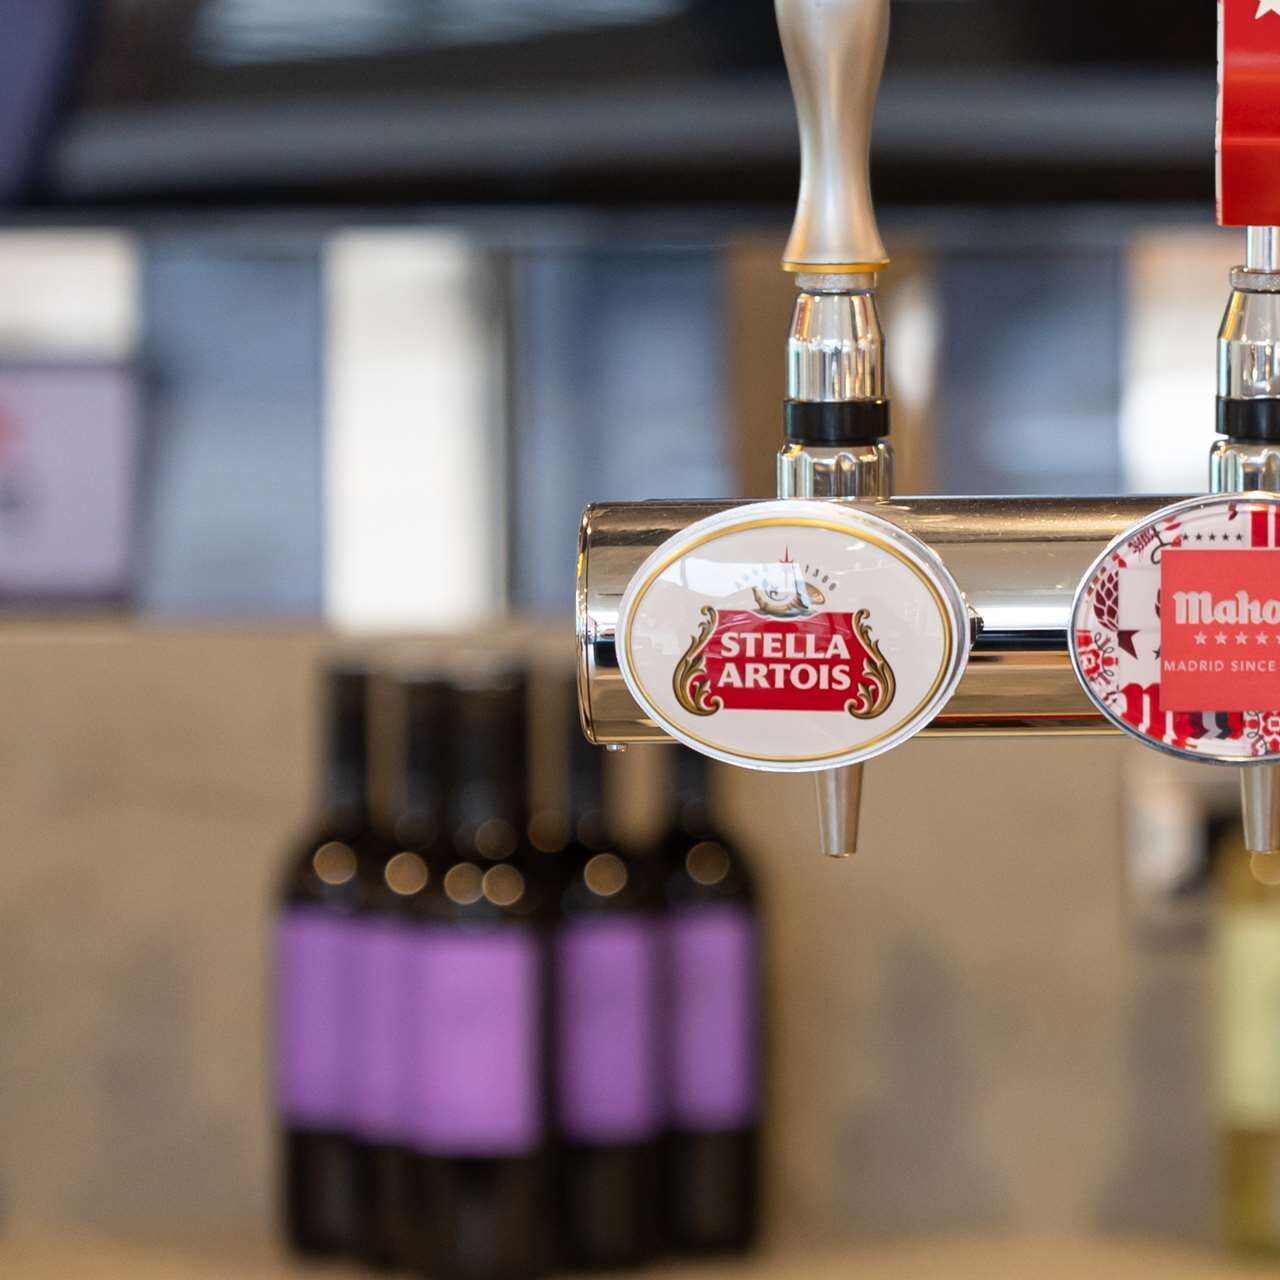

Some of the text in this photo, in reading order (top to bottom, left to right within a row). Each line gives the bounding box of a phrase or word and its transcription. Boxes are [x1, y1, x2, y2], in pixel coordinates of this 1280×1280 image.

[720, 632, 850, 660] STELLA
[717, 663, 851, 691] ARTOIS
[1164, 659, 1225, 673] MADRID
[1231, 659, 1276, 673] SINCE
